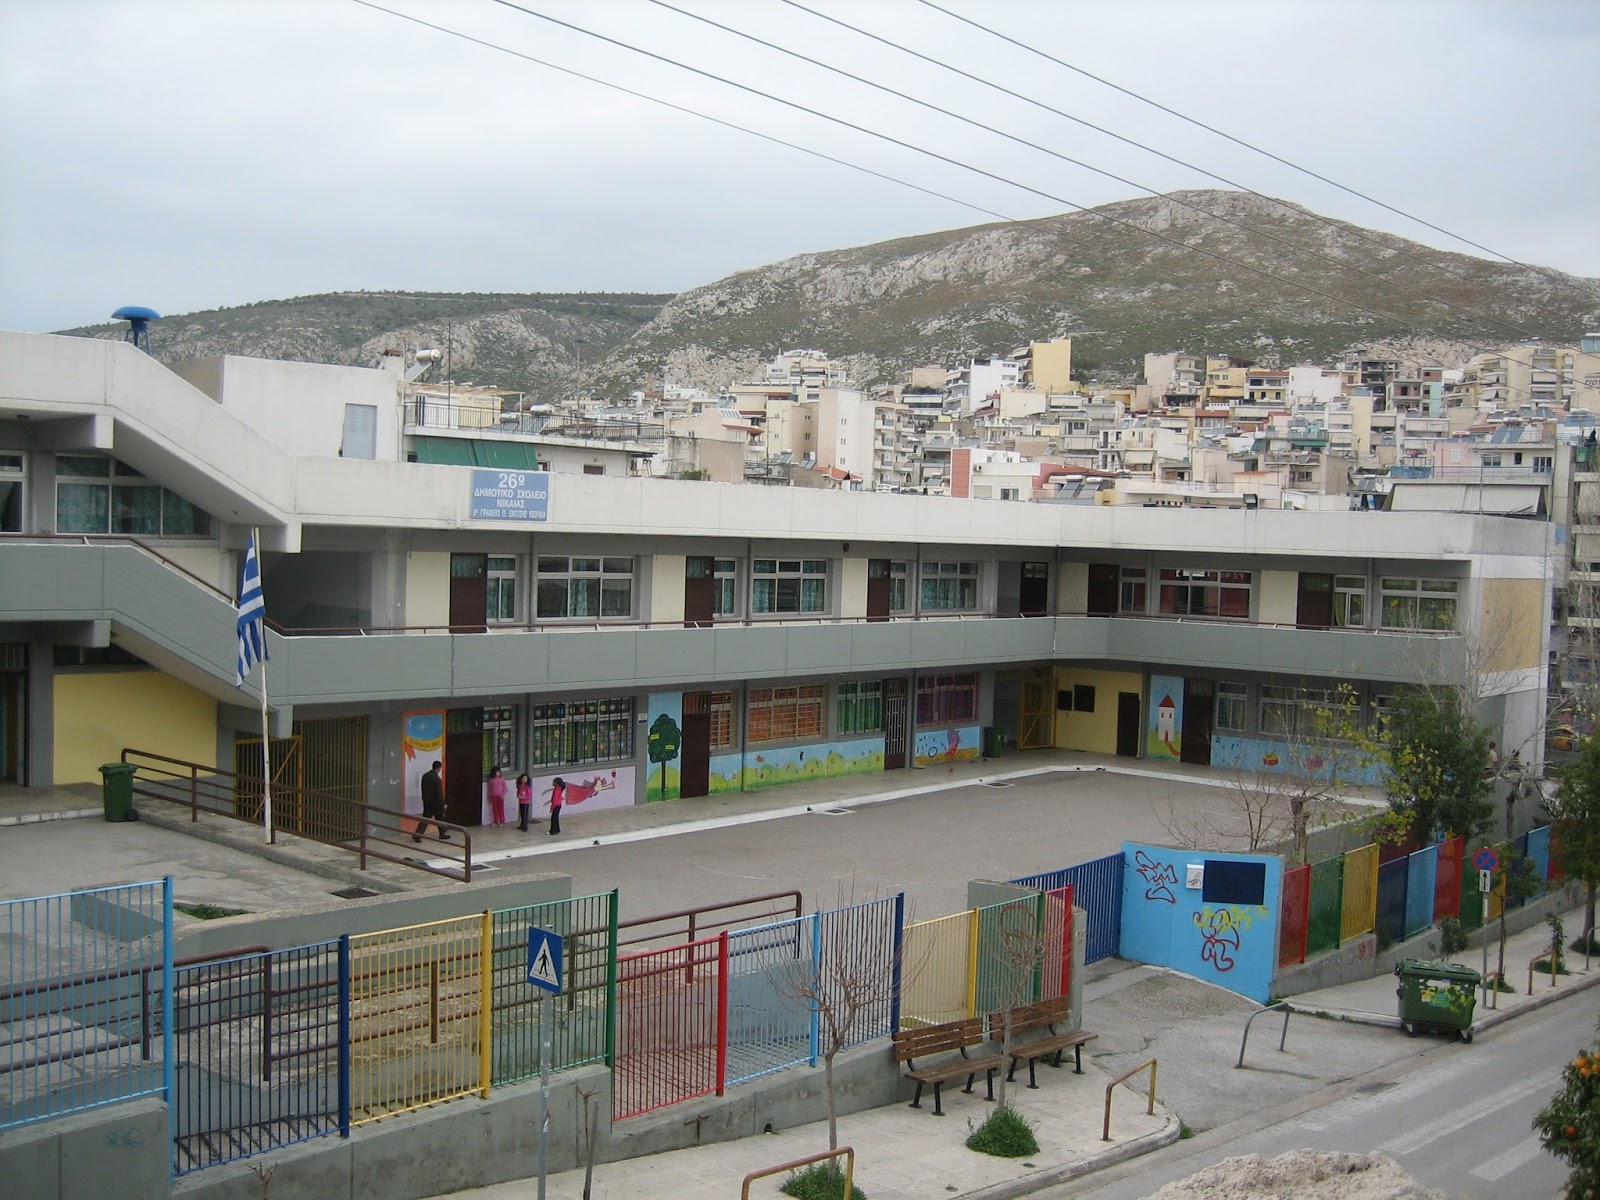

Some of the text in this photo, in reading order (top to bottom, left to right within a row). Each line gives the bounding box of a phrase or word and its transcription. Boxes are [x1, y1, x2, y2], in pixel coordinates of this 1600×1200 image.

[474, 488, 547, 500] ΔΗΜΟΤΙΚΟ ΣΧΟΛΕΙΟ
[496, 499, 525, 508] ΝΙΚΑΙΑΣ
